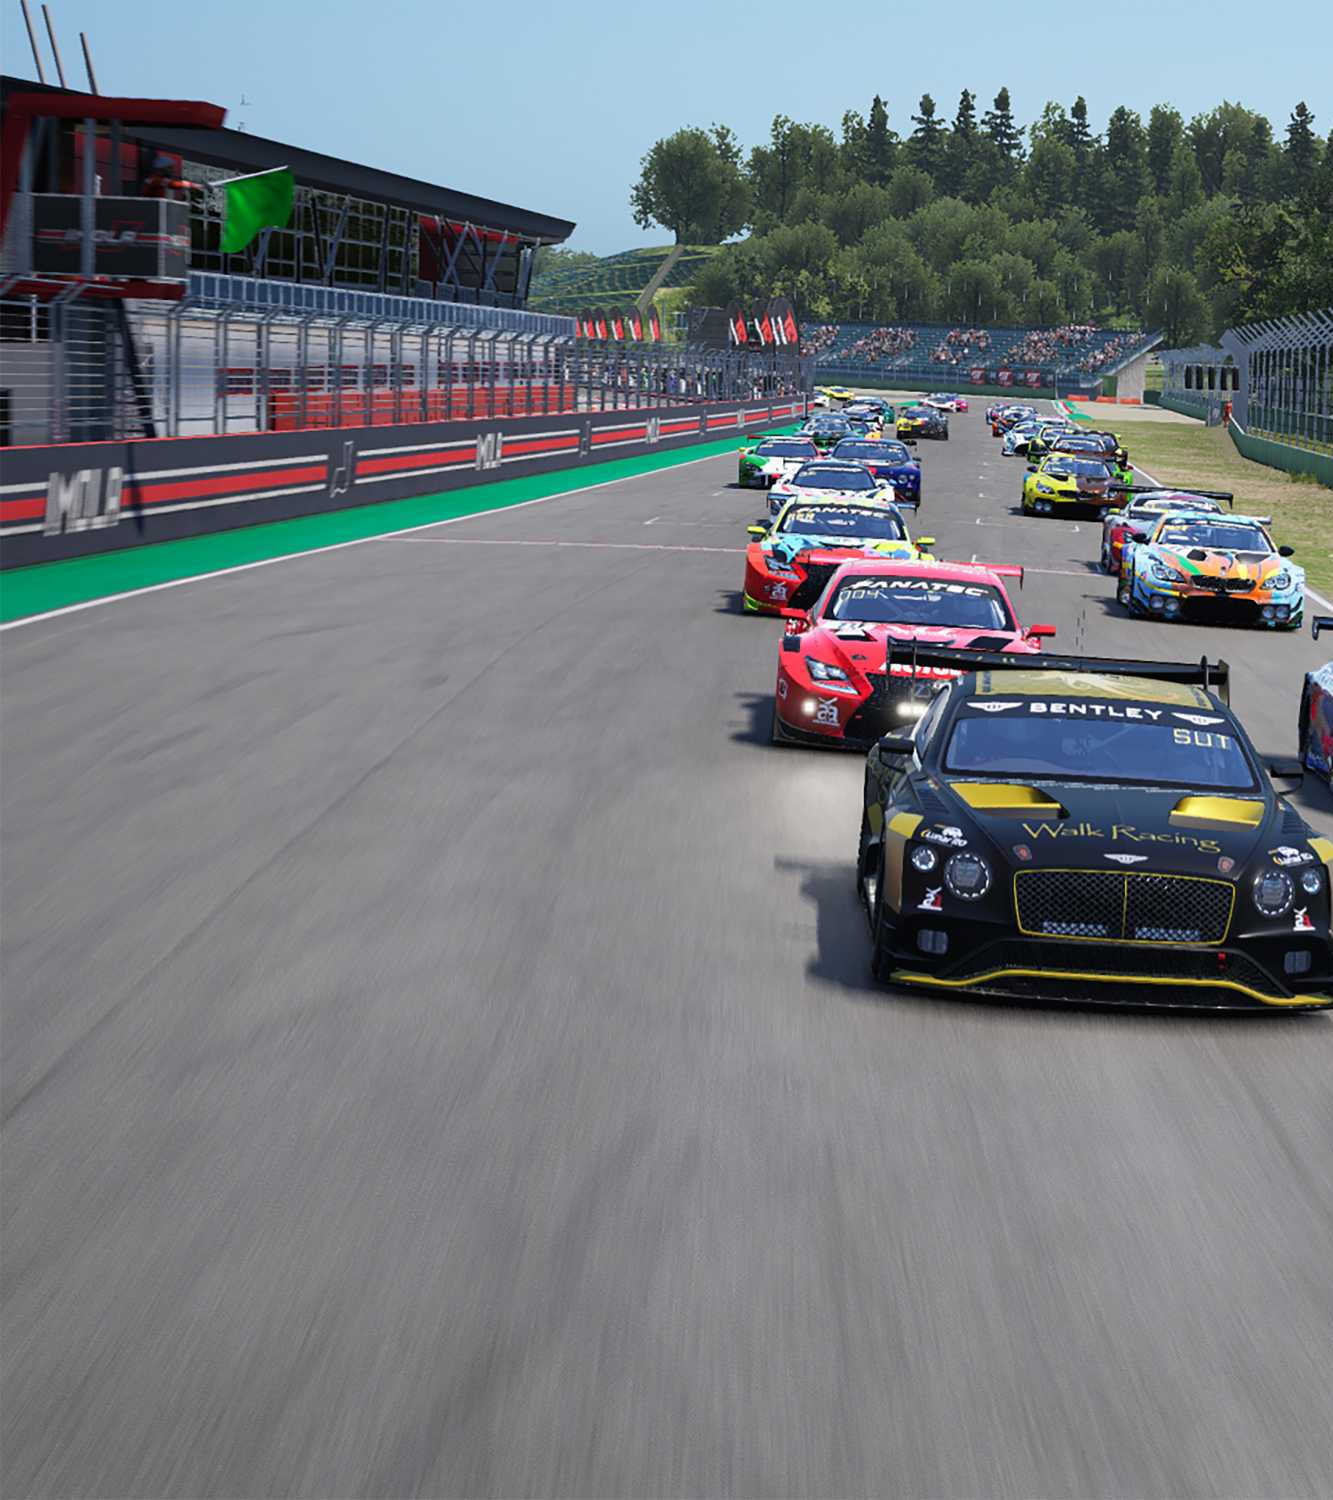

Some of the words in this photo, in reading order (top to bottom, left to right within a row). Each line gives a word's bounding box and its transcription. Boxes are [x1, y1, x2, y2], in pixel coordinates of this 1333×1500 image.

[851, 579, 989, 597] FANATEC
[1028, 701, 1163, 721] BENTLEY
[1172, 727, 1231, 750] SUT
[1022, 822, 1105, 840] Walk
[1111, 824, 1222, 854] Racing
